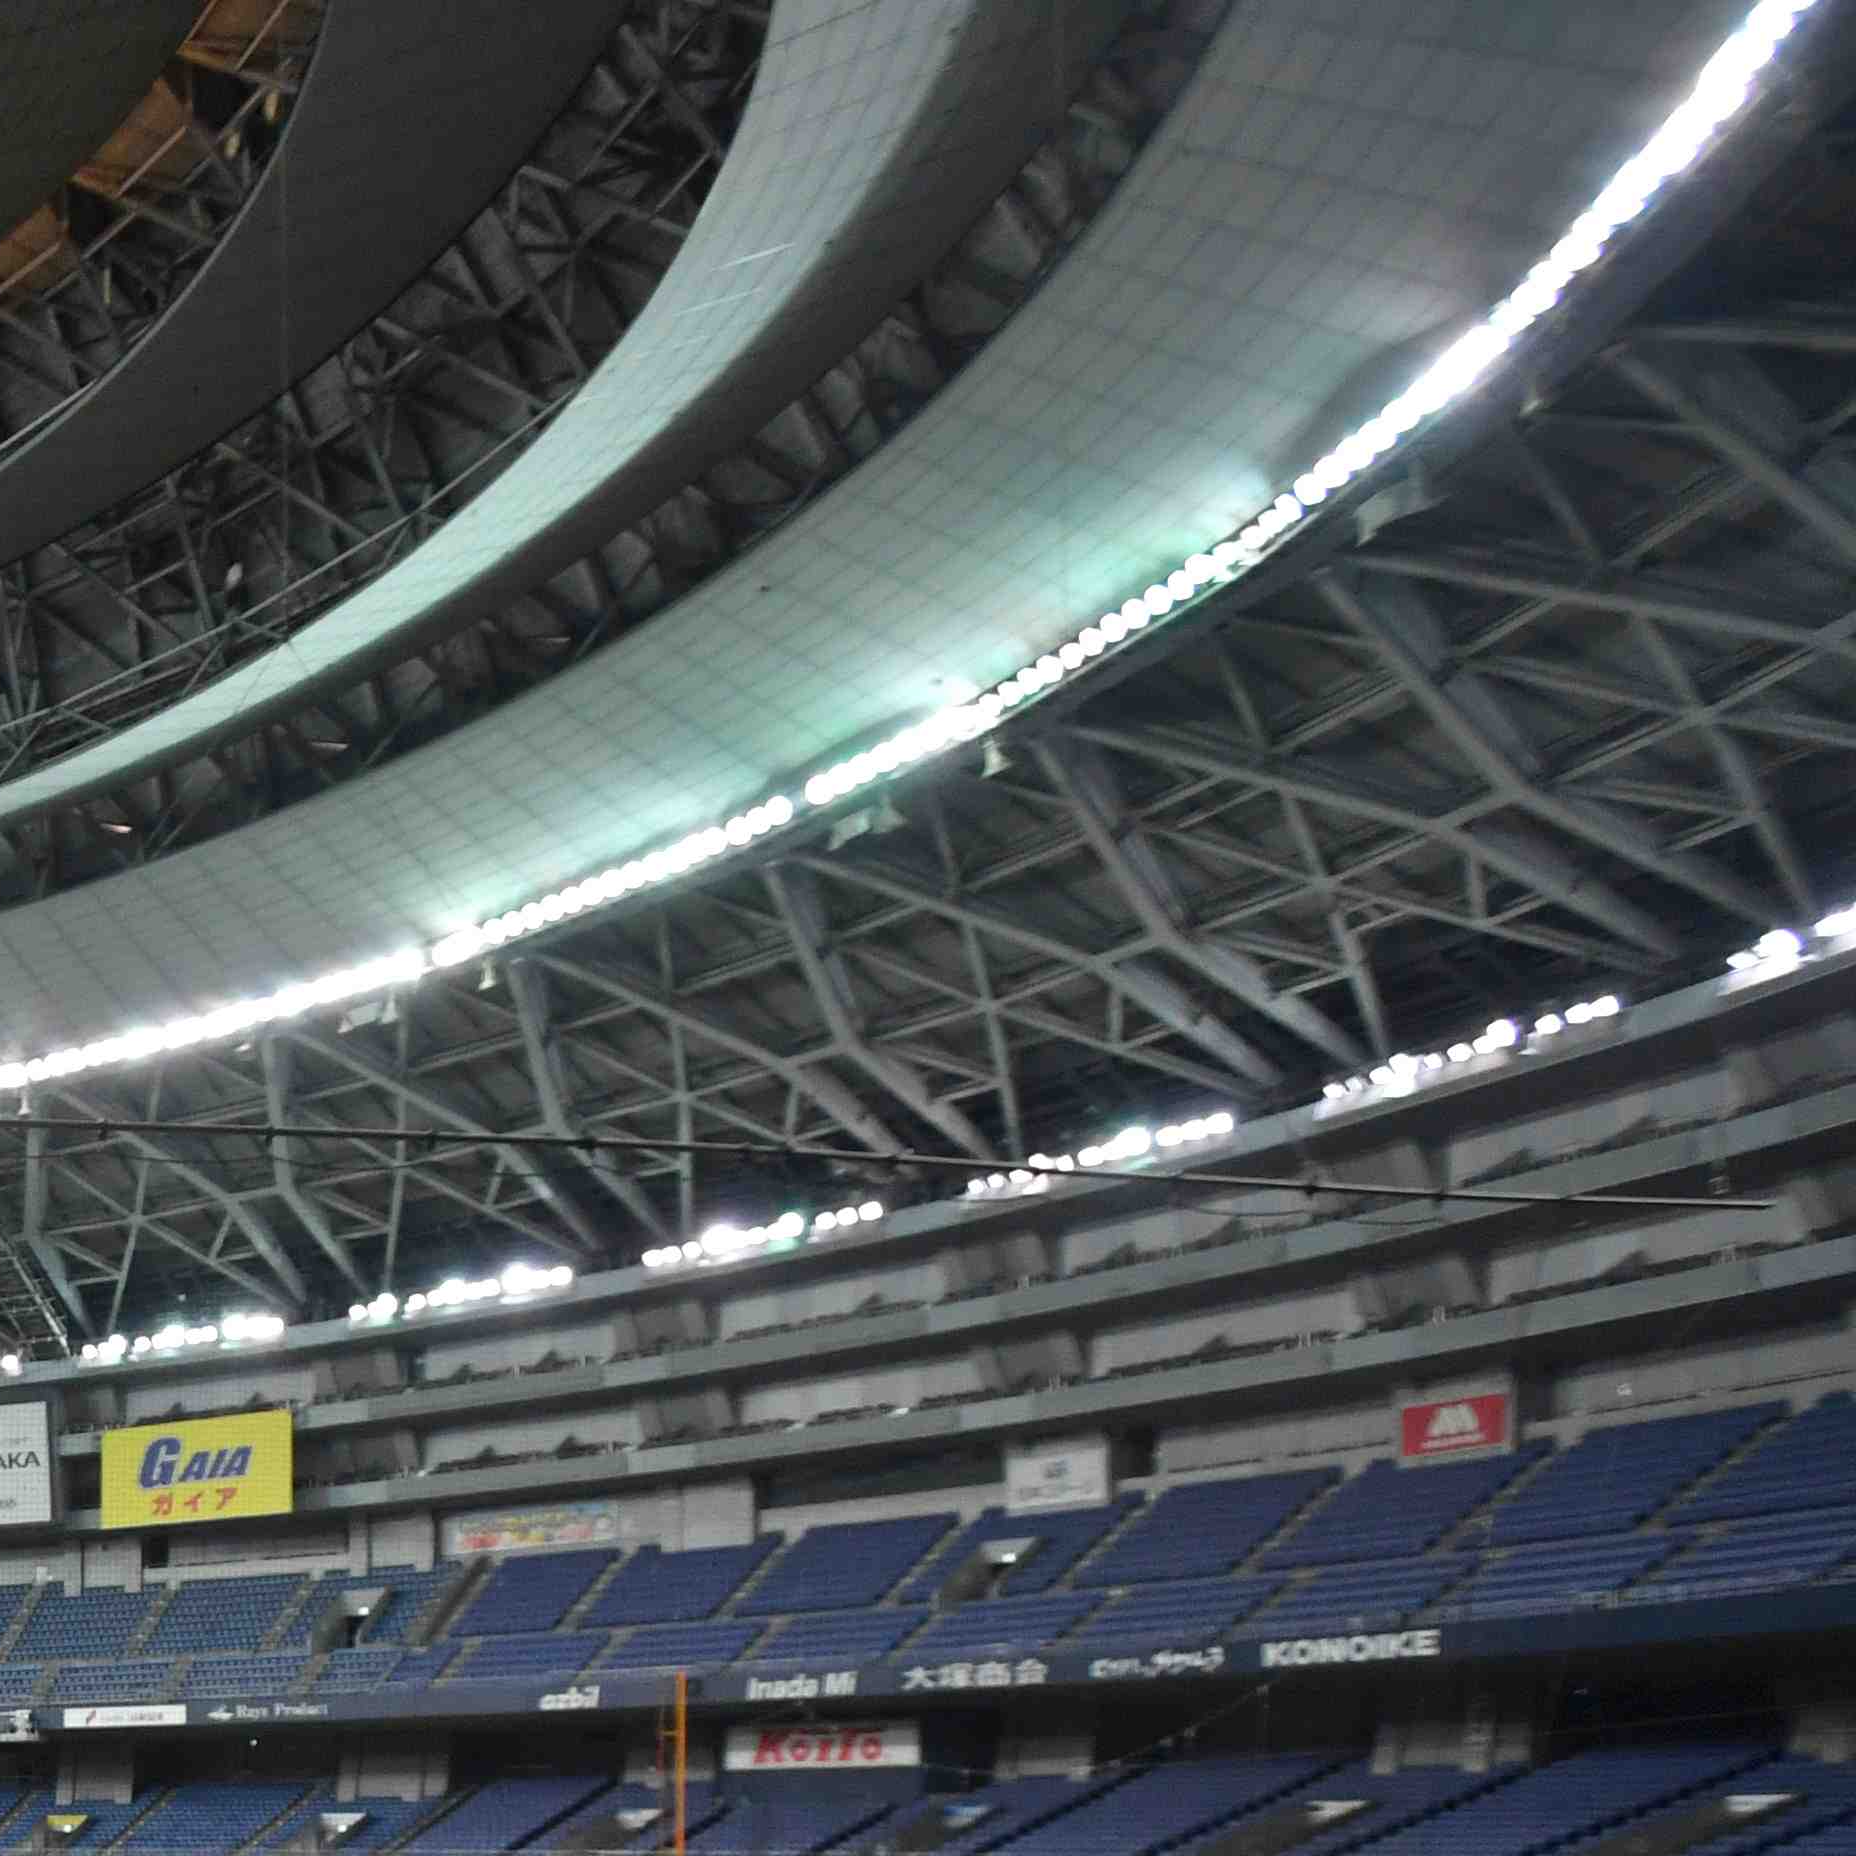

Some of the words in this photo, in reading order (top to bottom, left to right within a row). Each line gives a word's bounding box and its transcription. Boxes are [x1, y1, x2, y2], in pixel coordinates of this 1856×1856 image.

[138, 1436, 253, 1491] GAIA
[151, 1487, 238, 1515] ガイア
[1262, 1630, 1442, 1667] KONOIKE
